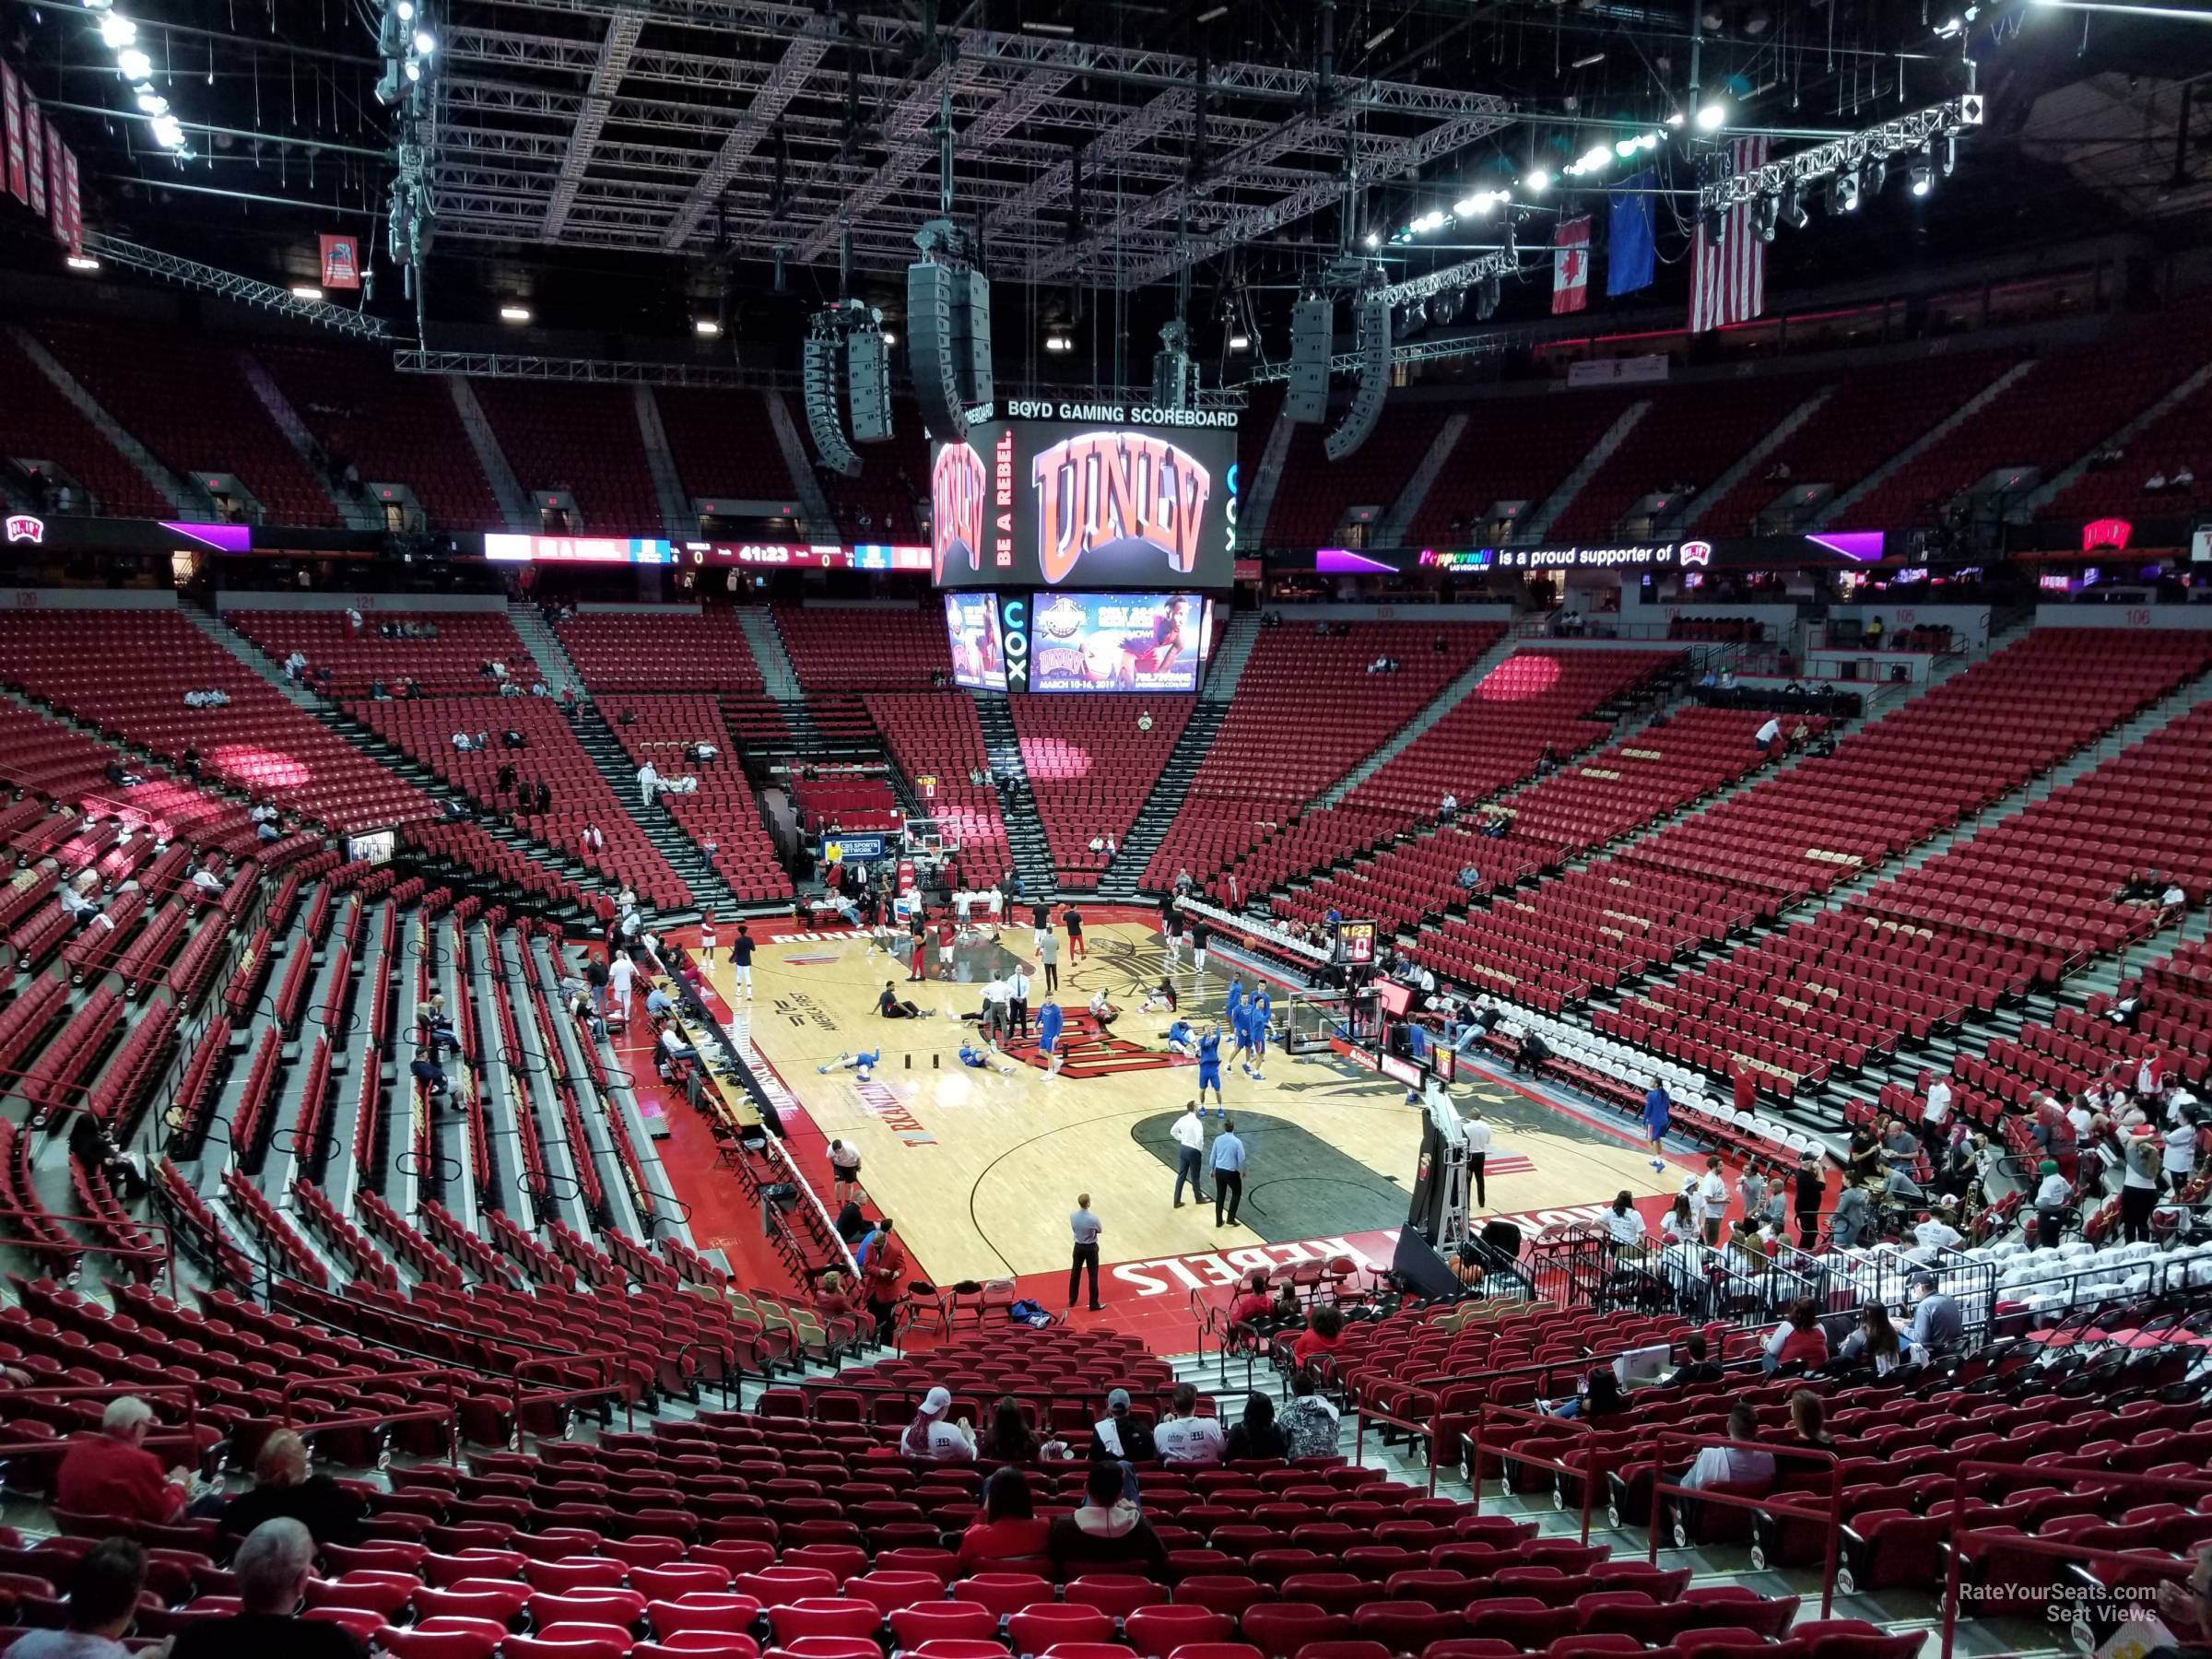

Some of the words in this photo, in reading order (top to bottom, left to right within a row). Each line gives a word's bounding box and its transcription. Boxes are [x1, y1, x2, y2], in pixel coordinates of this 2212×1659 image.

[1008, 400, 1053, 418] BOYD
[1060, 404, 1124, 422] GAMING
[1131, 406, 1239, 427] SCOREBOARD
[997, 429, 1012, 505] REBEL.
[1031, 431, 1210, 584] UNLV
[997, 512, 1012, 531] A
[694, 551, 704, 565] 0
[739, 546, 789, 562] 41:23
[997, 538, 1012, 566] BE
[1419, 549, 1493, 567] Peppermill
[1499, 549, 1512, 565] is
[1516, 554, 1526, 564] a
[1531, 547, 1576, 567] proud
[1579, 546, 1654, 567] supporter
[1656, 545, 1673, 561] of
[821, 555, 830, 567] 0
[17, 592, 37, 607] 120
[356, 596, 374, 608] 121
[1896, 609, 1915, 623] 105
[2127, 610, 2151, 625] 106
[1005, 601, 1027, 681] COX
[1039, 647, 1086, 675] UNLV
[1341, 925, 1372, 937] 41:23
